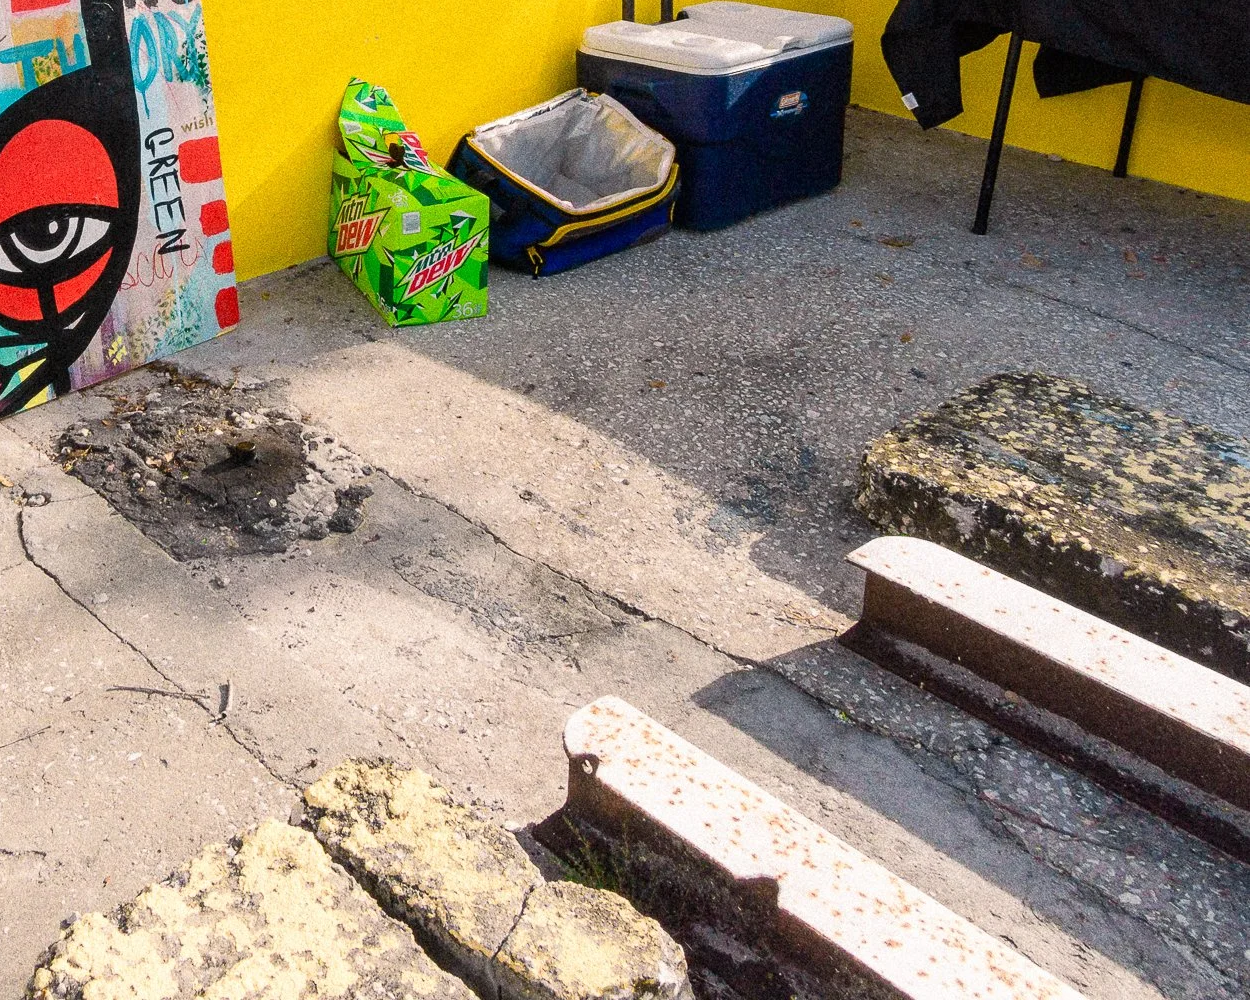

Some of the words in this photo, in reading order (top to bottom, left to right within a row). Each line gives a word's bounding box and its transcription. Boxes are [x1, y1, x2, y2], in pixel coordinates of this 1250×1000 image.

[180, 114, 214, 135] wish
[145, 127, 190, 255] GREEN
[452, 301, 474, 319] 36
